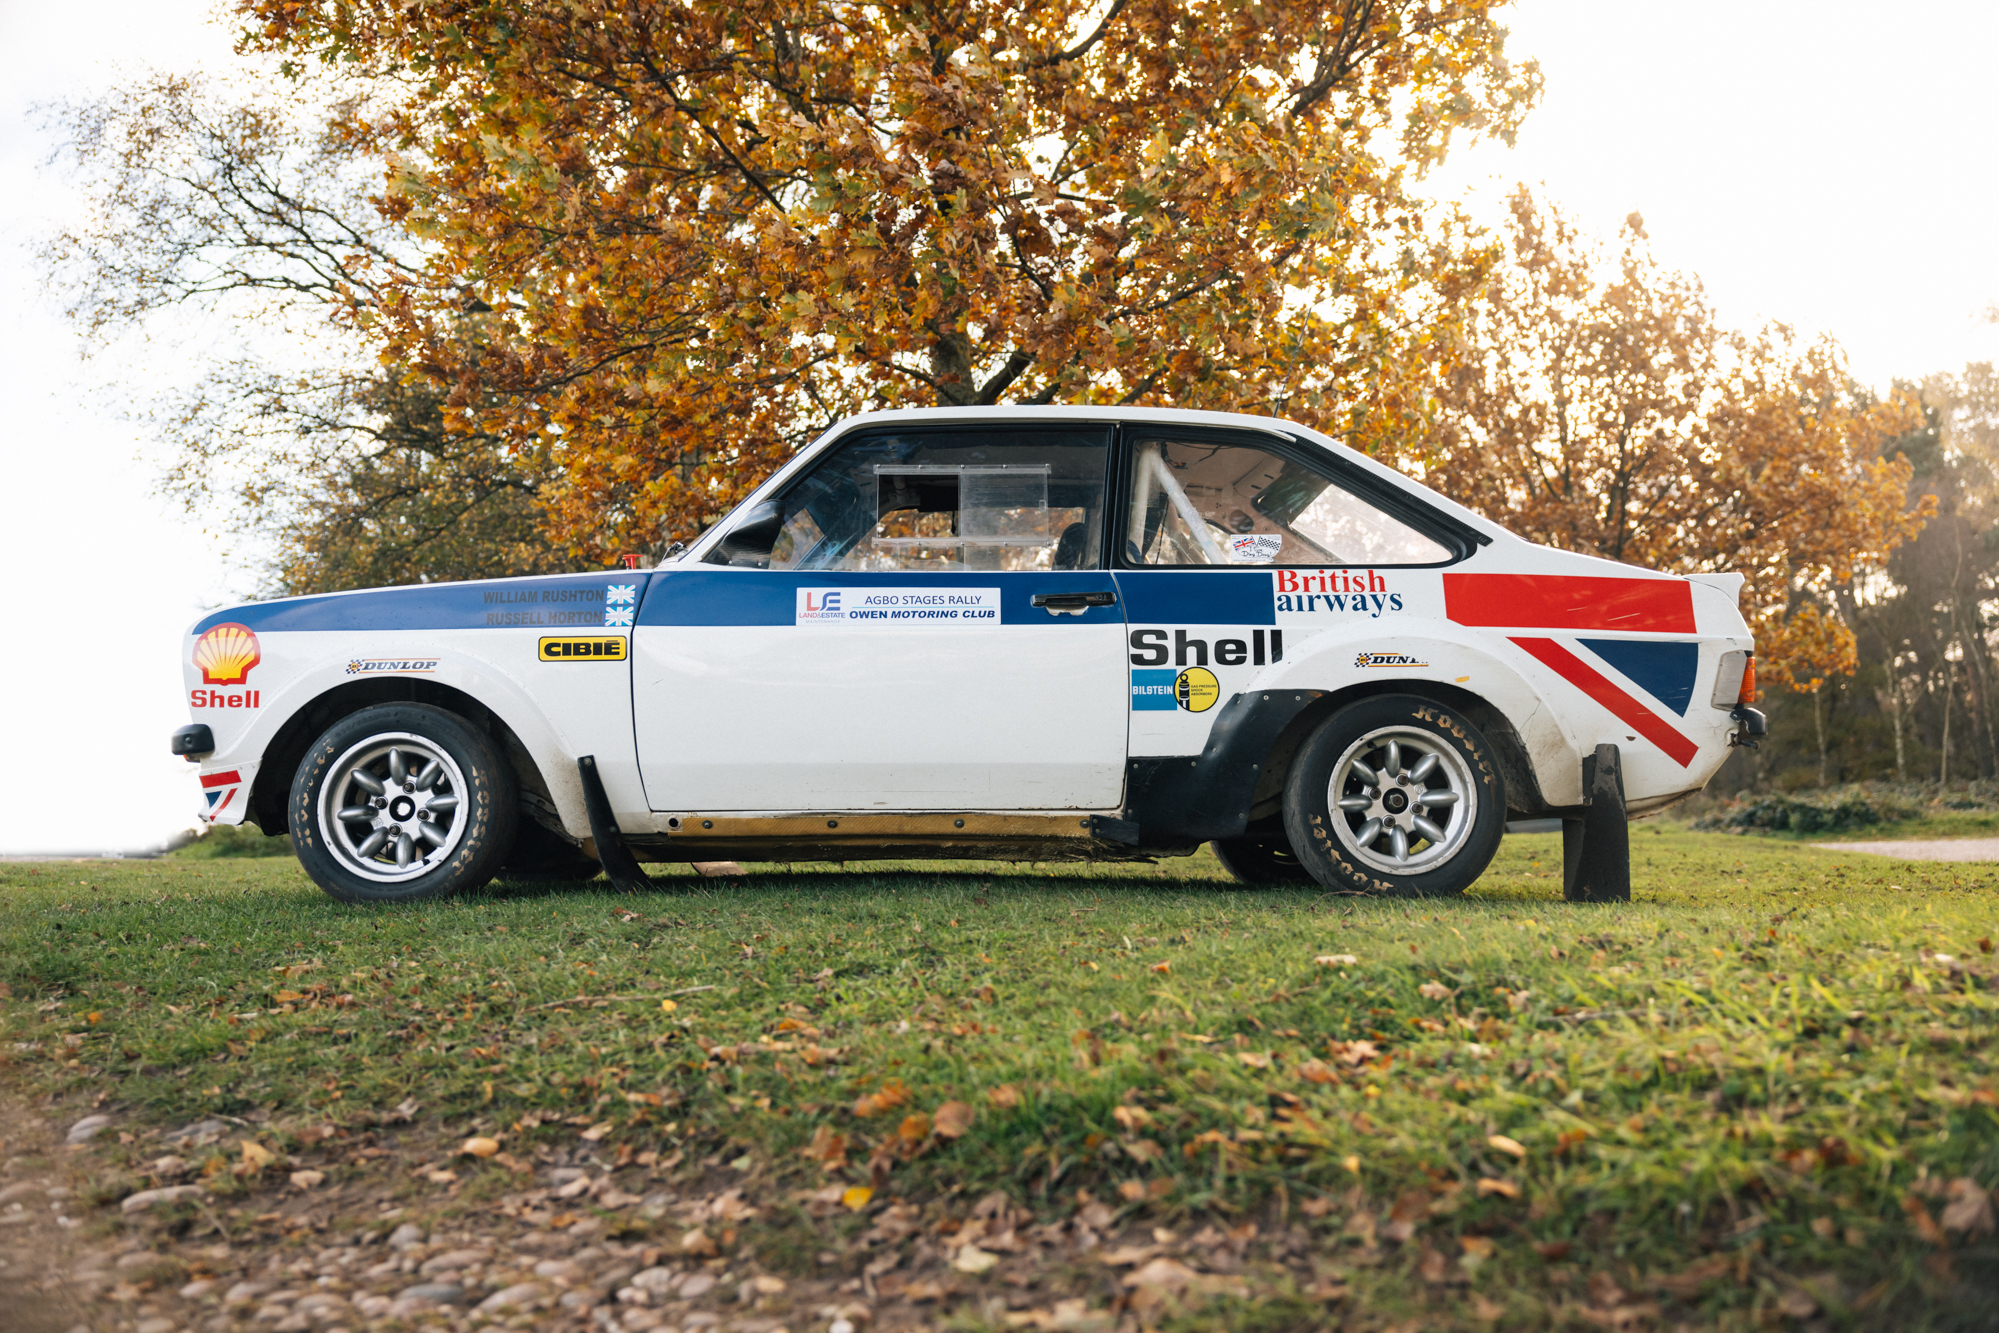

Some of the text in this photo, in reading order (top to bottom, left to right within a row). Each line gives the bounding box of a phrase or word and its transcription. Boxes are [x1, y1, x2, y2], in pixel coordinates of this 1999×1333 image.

[1276, 570, 1387, 593] British
[483, 589, 604, 604] WILLIAM RUSHTON
[865, 595, 982, 605] AGBO STAGES RALLY
[1277, 592, 1403, 618] airways
[486, 611, 602, 625] RUSSELL HORTON
[849, 610, 995, 619] OWEN MOTORING CLUB
[1130, 629, 1283, 666] Shell
[362, 661, 438, 670] DUNLOP
[1132, 685, 1173, 695] BILSTEIN
[191, 690, 260, 708] Shell
